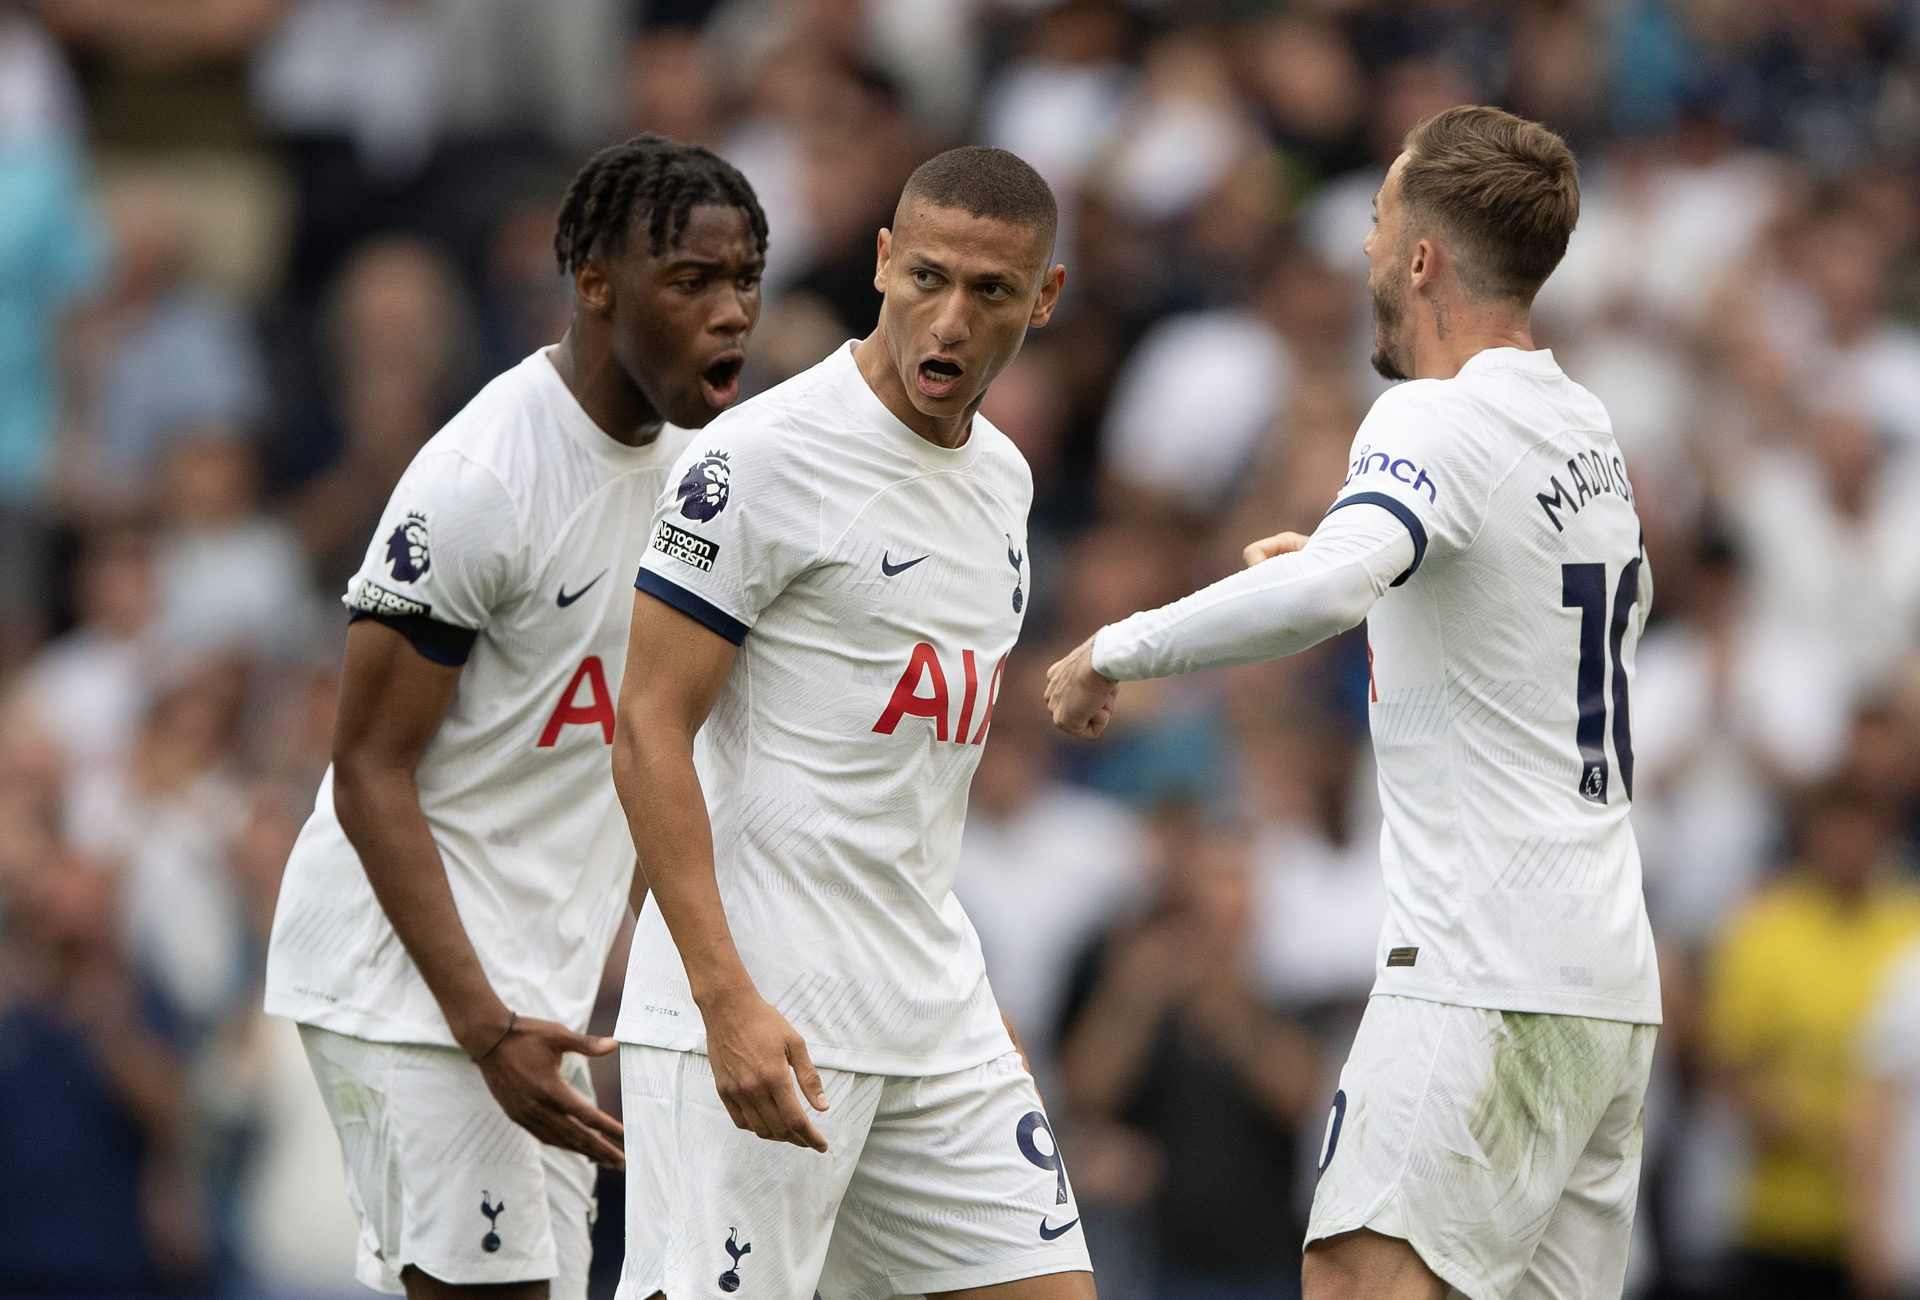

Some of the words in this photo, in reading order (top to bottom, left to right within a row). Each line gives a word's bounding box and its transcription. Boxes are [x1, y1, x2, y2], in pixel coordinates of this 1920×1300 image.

[1536, 449, 1636, 534] MADDIS
[657, 520, 672, 540] No
[672, 530, 711, 557] room
[667, 542, 713, 572] racism
[362, 580, 383, 601] No
[381, 592, 425, 616] room
[1016, 1111, 1068, 1205] 9
